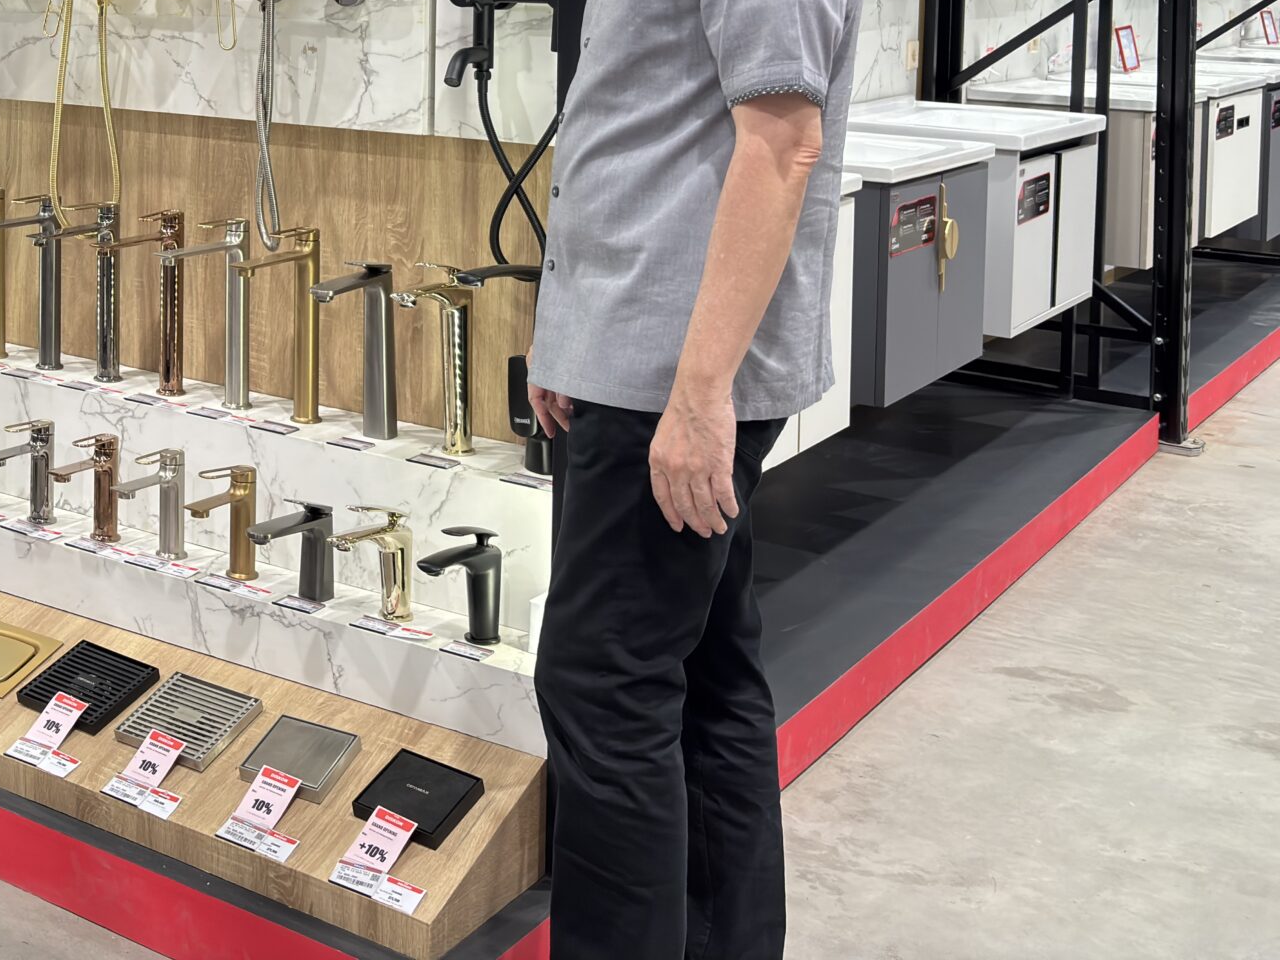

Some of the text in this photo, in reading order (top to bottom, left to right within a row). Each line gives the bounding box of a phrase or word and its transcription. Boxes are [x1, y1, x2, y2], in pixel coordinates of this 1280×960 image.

[43, 719, 63, 735] 10%
[138, 759, 160, 775] 10%
[251, 797, 274, 815] 10%
[358, 841, 389, 863] +10%
